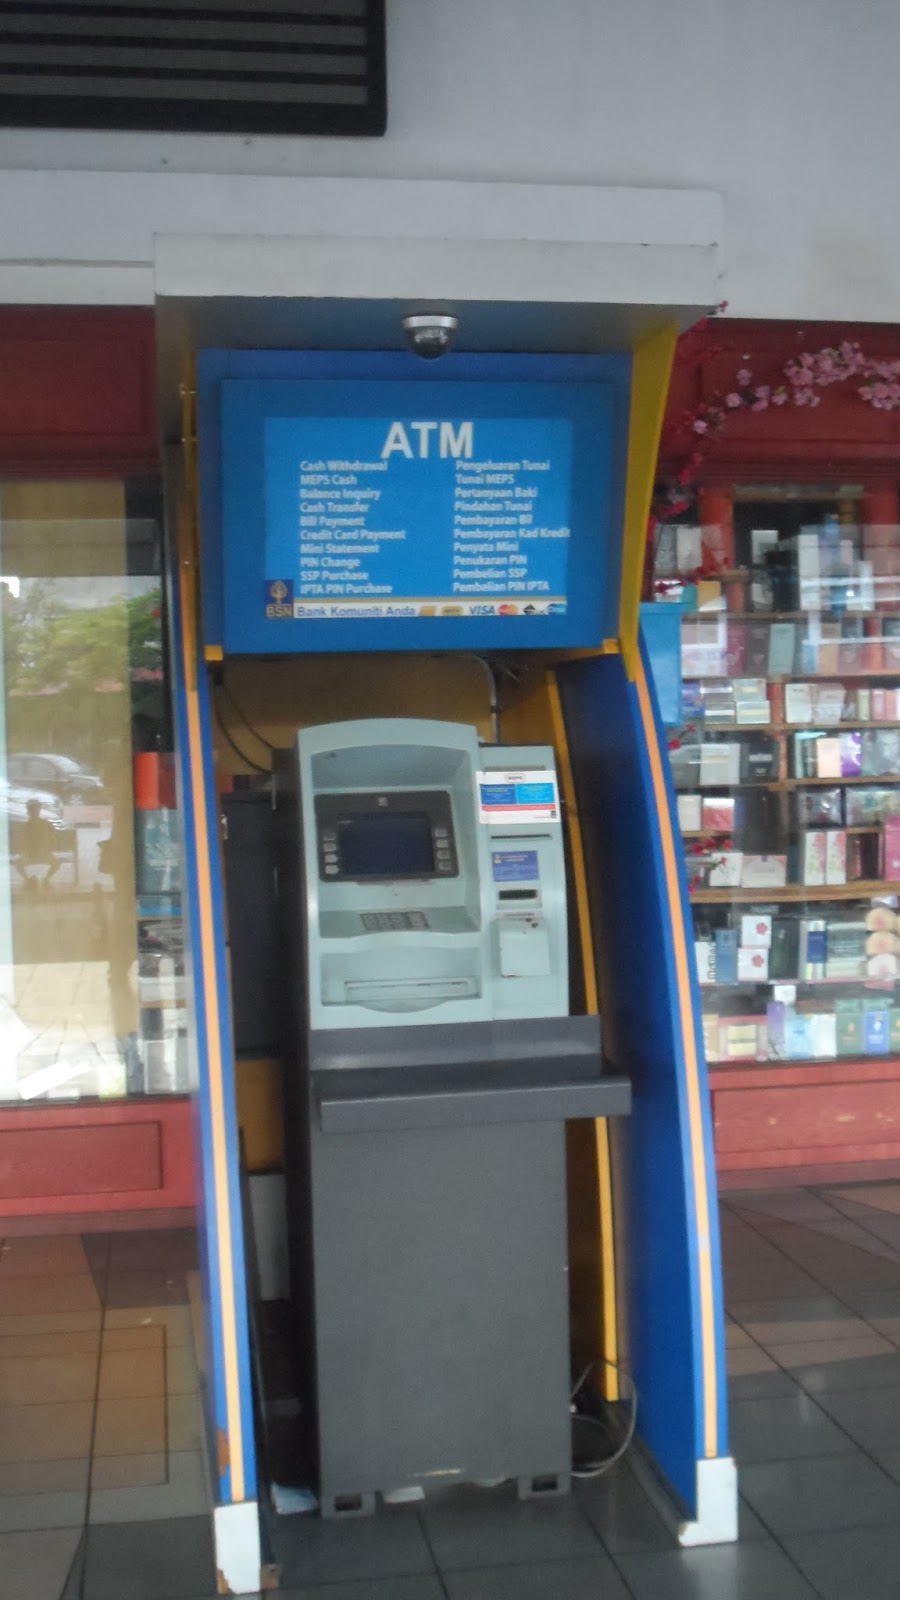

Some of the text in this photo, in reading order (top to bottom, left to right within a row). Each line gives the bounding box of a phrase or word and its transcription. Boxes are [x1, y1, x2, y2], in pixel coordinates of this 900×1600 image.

[380, 421, 473, 459] ATM
[300, 460, 388, 471] Cash Withdrawal
[456, 460, 550, 472] Pengeluaran Tunai
[300, 474, 357, 485] MEPS Cash
[456, 474, 515, 484] Tunai MEPS
[300, 488, 381, 501] Balance Inquiry
[455, 487, 538, 499] Pertanyaan Baki
[300, 502, 369, 512] Cash Transfer
[454, 501, 533, 511] Pindahan Tunai
[300, 516, 365, 528] Bill Payment
[454, 514, 533, 527] Pembayaran Bil
[300, 530, 406, 541] Credit Card Payment
[454, 528, 571, 540] Pembayaran Kad Kredit
[300, 544, 379, 553] Mini Statement
[453, 541, 519, 553] Penyata Mini
[300, 557, 360, 569] PIN Change
[453, 555, 528, 565] Penukaran PIN
[300, 570, 368, 580] SSP Purchase
[453, 568, 527, 578] Pembelian SSP
[300, 583, 392, 594] IPTA PIN Purchase
[453, 581, 550, 592] Pembelian PIN IPTA
[265, 606, 292, 617] BSN
[297, 606, 416, 617] Bank Komuniti Anda
[469, 605, 496, 615] VISA
